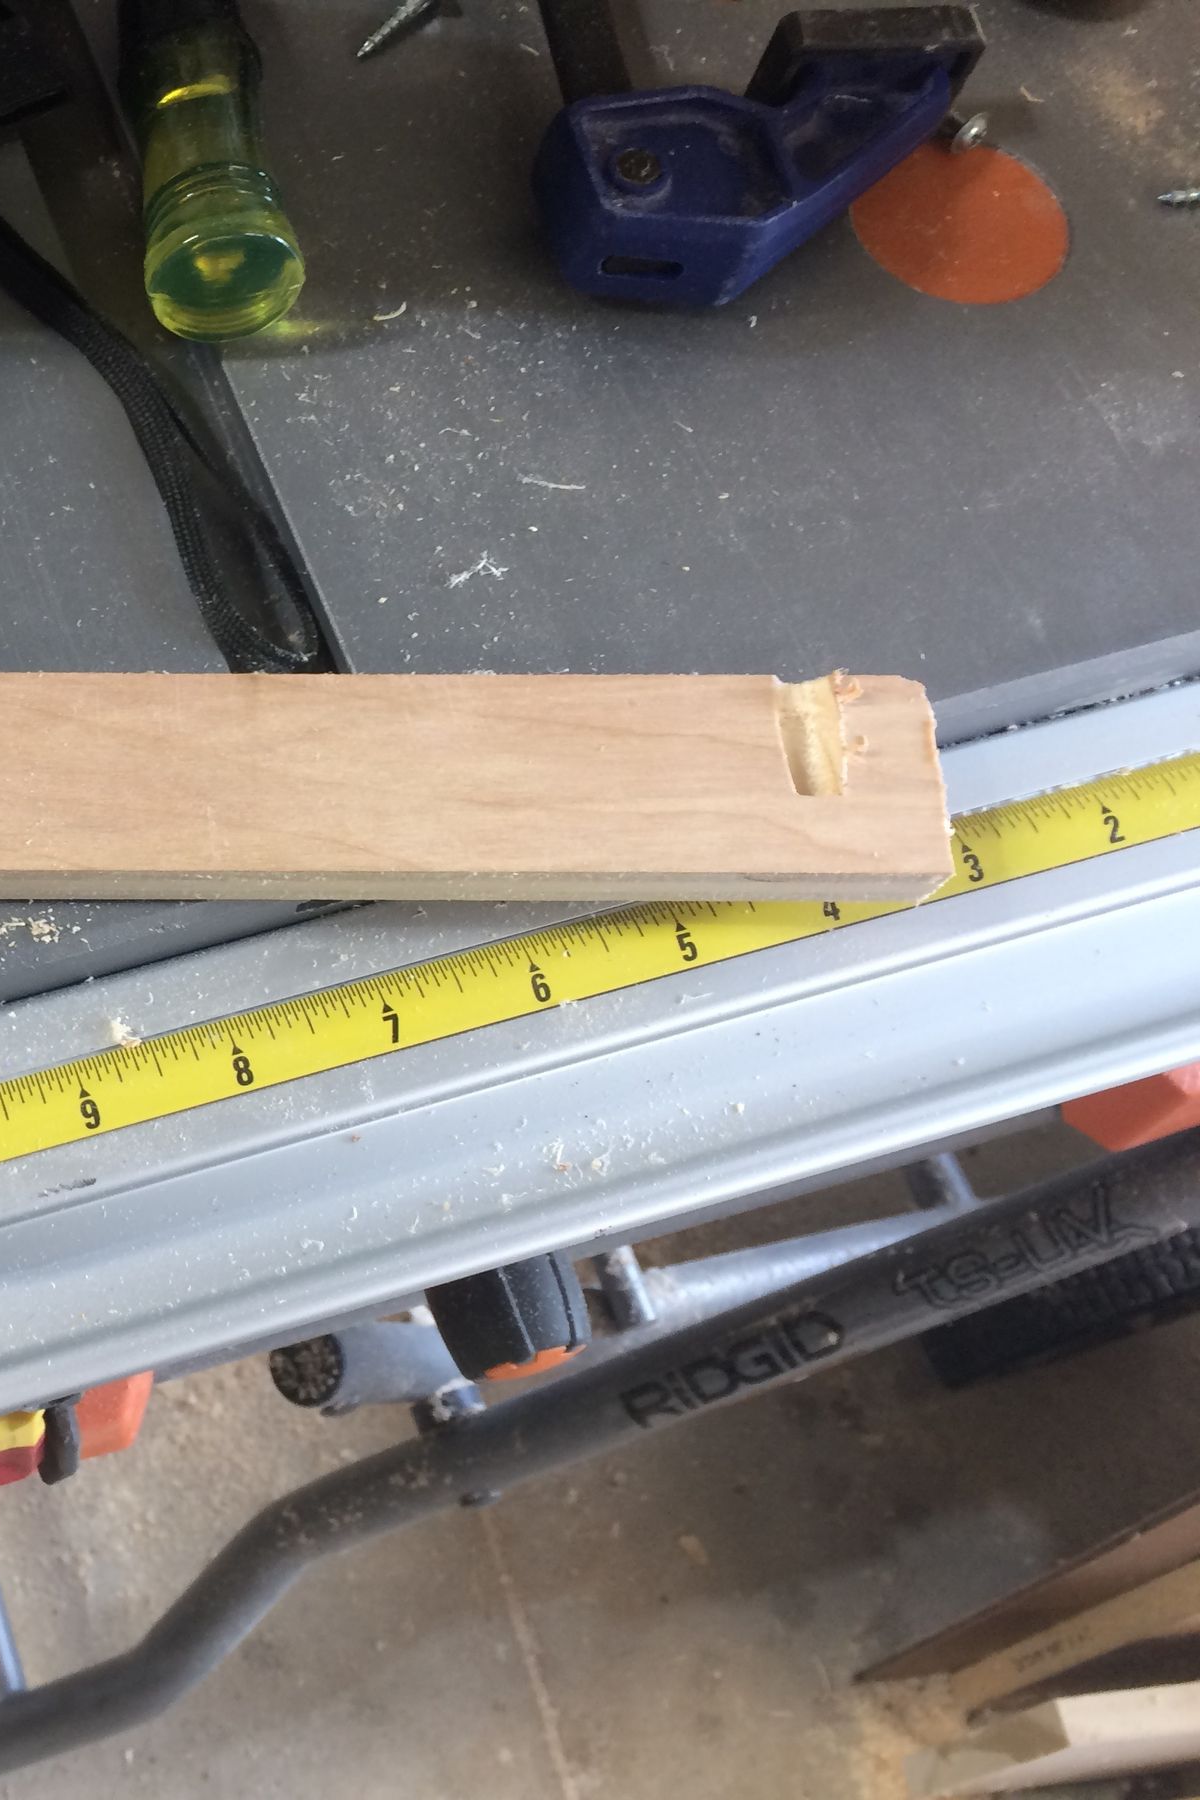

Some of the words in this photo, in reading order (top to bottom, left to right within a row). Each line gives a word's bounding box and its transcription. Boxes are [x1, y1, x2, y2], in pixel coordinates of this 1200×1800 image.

[80, 1099, 101, 1130] 9
[232, 1055, 254, 1086] 8
[382, 1013, 399, 1044] 7
[531, 973, 552, 1003] 6
[675, 932, 698, 962] 5
[823, 901, 840, 921] 4
[963, 854, 984, 882] 3
[1103, 815, 1126, 844] 2
[618, 1310, 847, 1428] RIDGID
